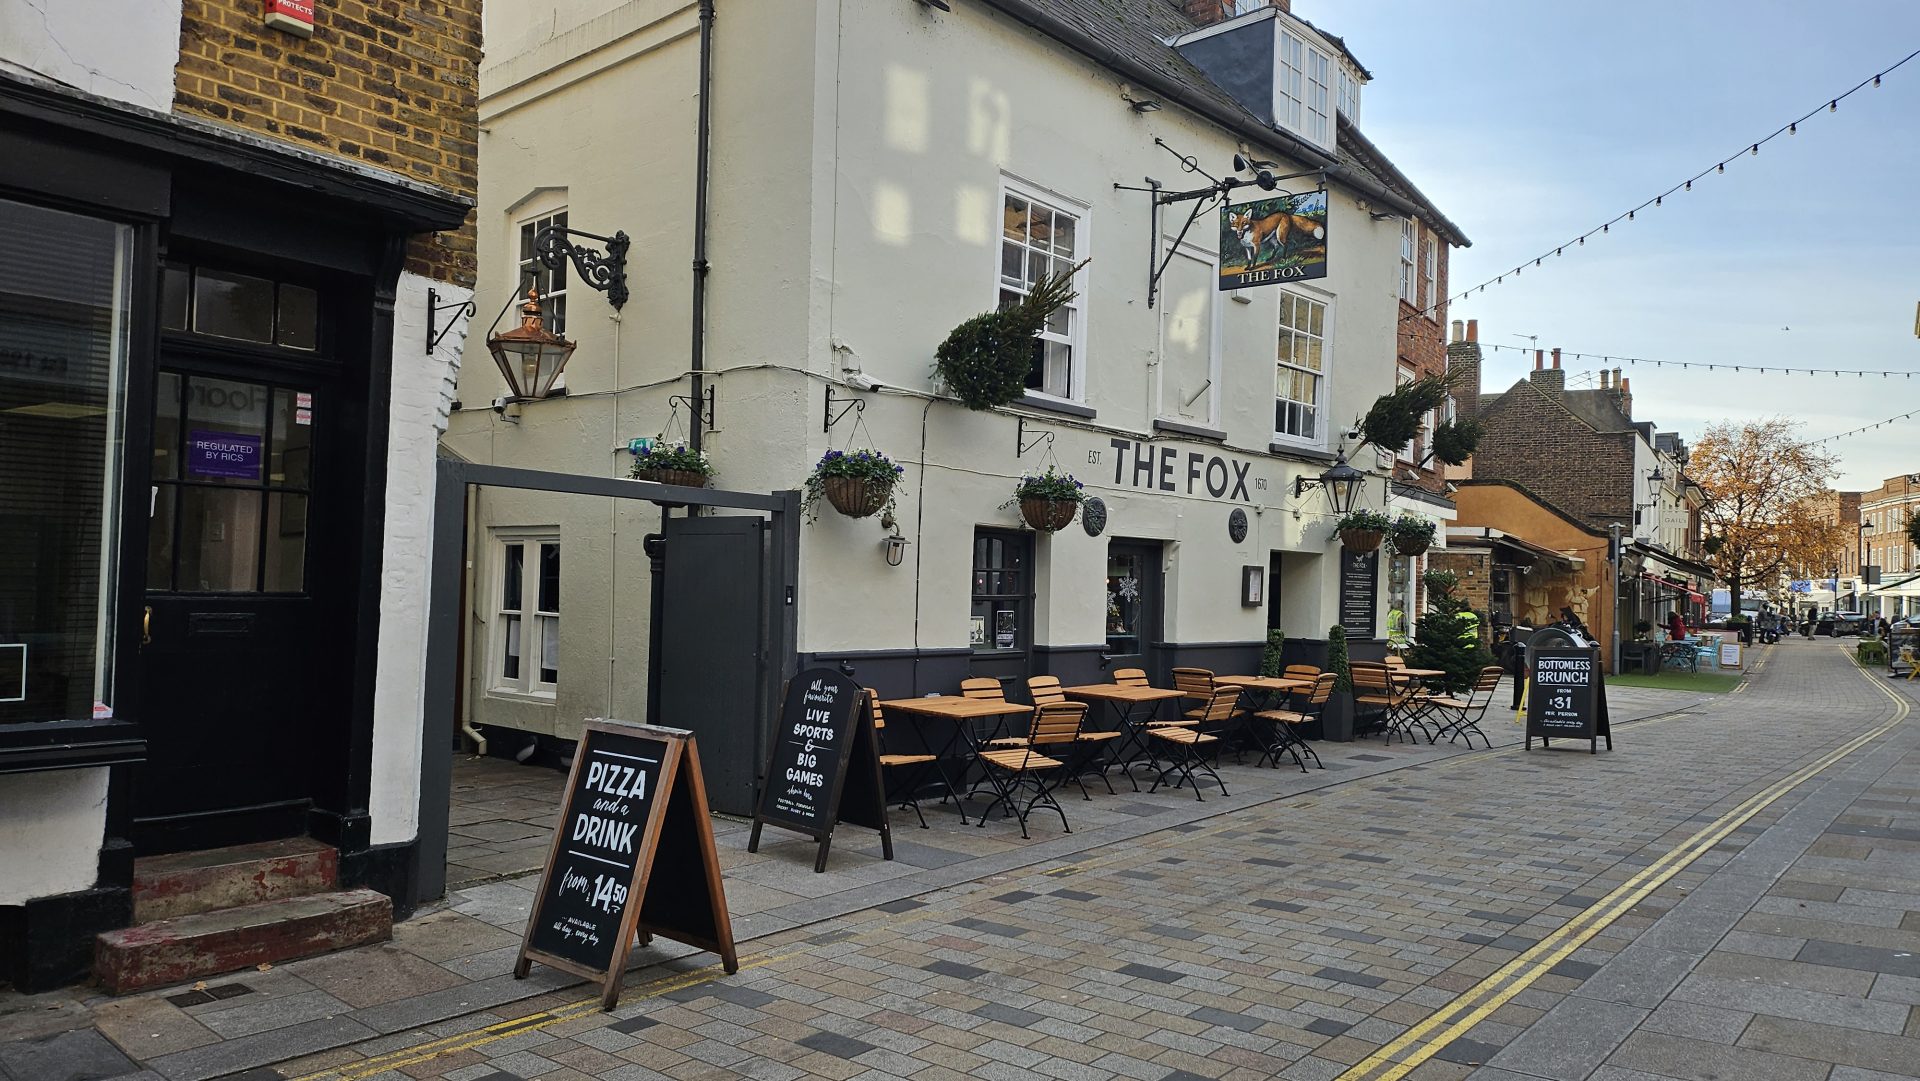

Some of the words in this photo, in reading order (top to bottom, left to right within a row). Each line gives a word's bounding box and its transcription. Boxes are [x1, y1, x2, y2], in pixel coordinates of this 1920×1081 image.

[1237, 271, 1270, 284] THE
[1274, 265, 1306, 279] FOX
[196, 441, 253, 454] REGULATED
[206, 451, 219, 459] BY
[221, 453, 244, 462] RICS
[1088, 450, 1102, 465] EST.
[1110, 438, 1177, 492] THE
[1187, 452, 1251, 501] FOX
[1538, 660, 1591, 671] BOTTOMLESS
[1537, 671, 1589, 683] BRUNCH
[803, 689, 834, 705] favourite
[806, 708, 830, 724] LIVE
[793, 723, 834, 741] SPORTS
[804, 739, 814, 752] &
[797, 753, 816, 768] BIG
[585, 761, 646, 800] PIZZA
[786, 767, 824, 787] GAMES
[593, 796, 622, 814] and
[620, 804, 630, 816] a
[573, 813, 638, 854] DRINK
[558, 866, 590, 897] from
[567, 917, 597, 931] AVAILABLE
